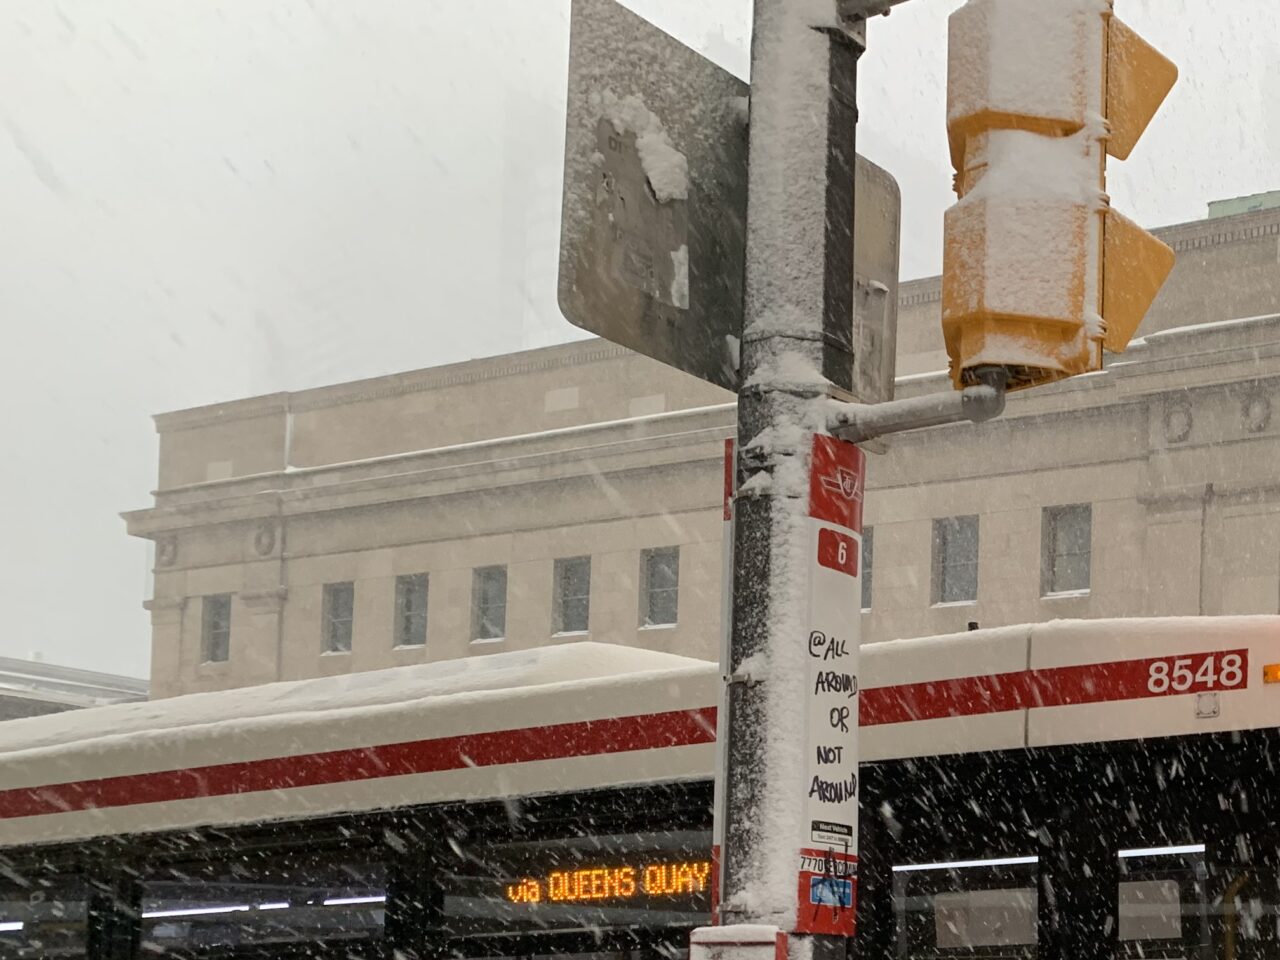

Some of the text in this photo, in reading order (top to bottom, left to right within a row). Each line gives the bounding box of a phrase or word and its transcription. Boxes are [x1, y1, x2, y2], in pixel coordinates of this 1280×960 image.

[838, 541, 847, 564] 6
[1147, 654, 1243, 694] 8548
[830, 706, 850, 733] OR
[817, 745, 843, 765] NOT
[508, 861, 710, 903] via QUEENS QUAY
